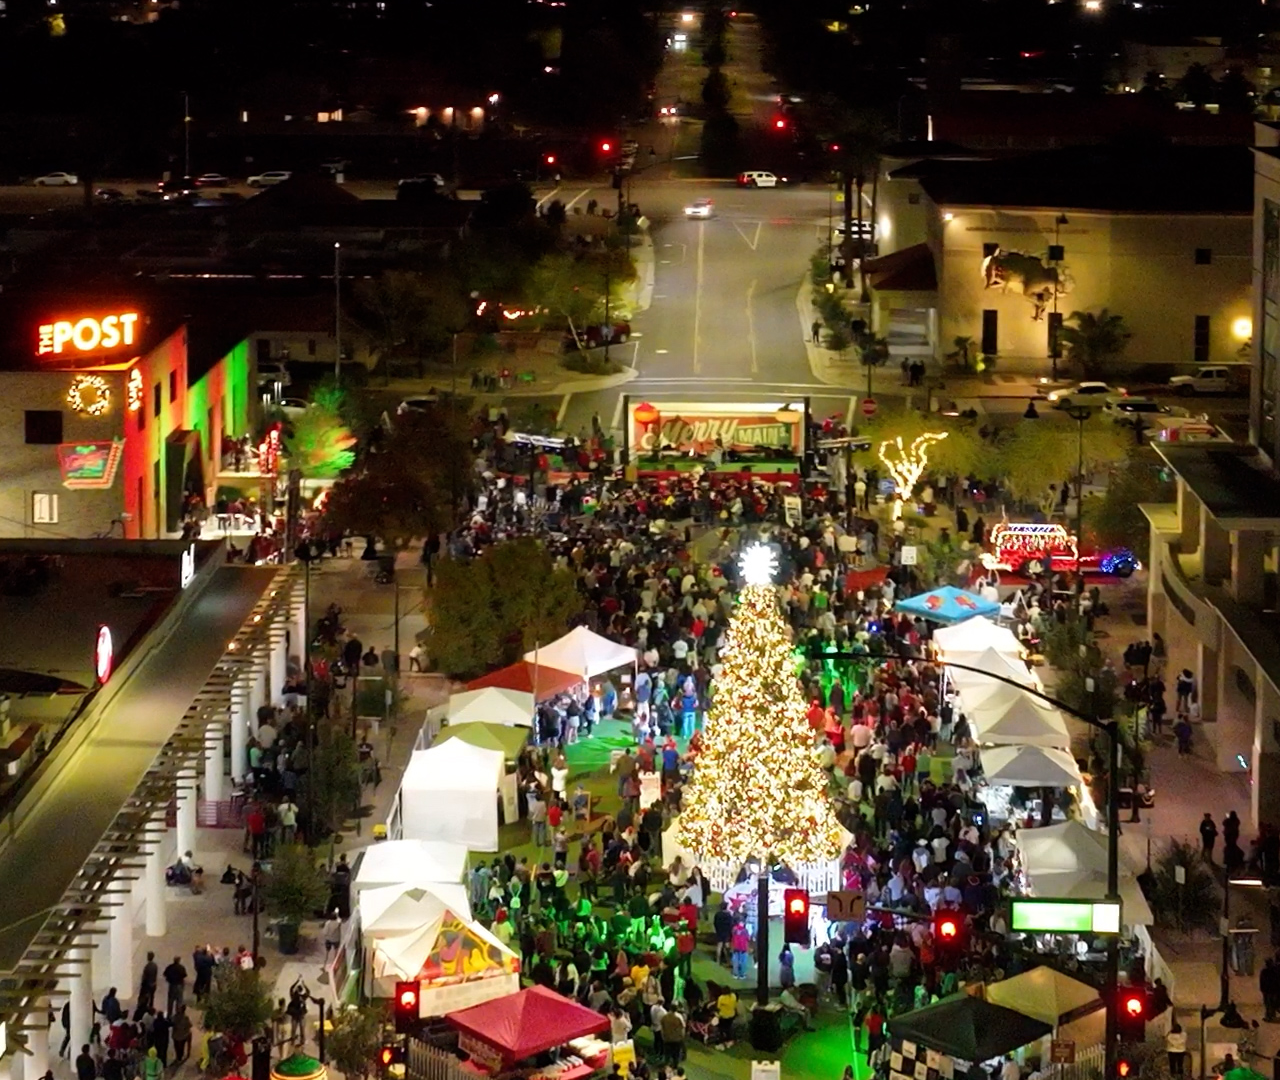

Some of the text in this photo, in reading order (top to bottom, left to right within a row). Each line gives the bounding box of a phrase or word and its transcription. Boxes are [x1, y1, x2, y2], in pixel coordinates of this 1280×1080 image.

[38, 312, 138, 355] THE POST
[661, 418, 740, 447] Merry
[738, 427, 778, 445] MAIN
